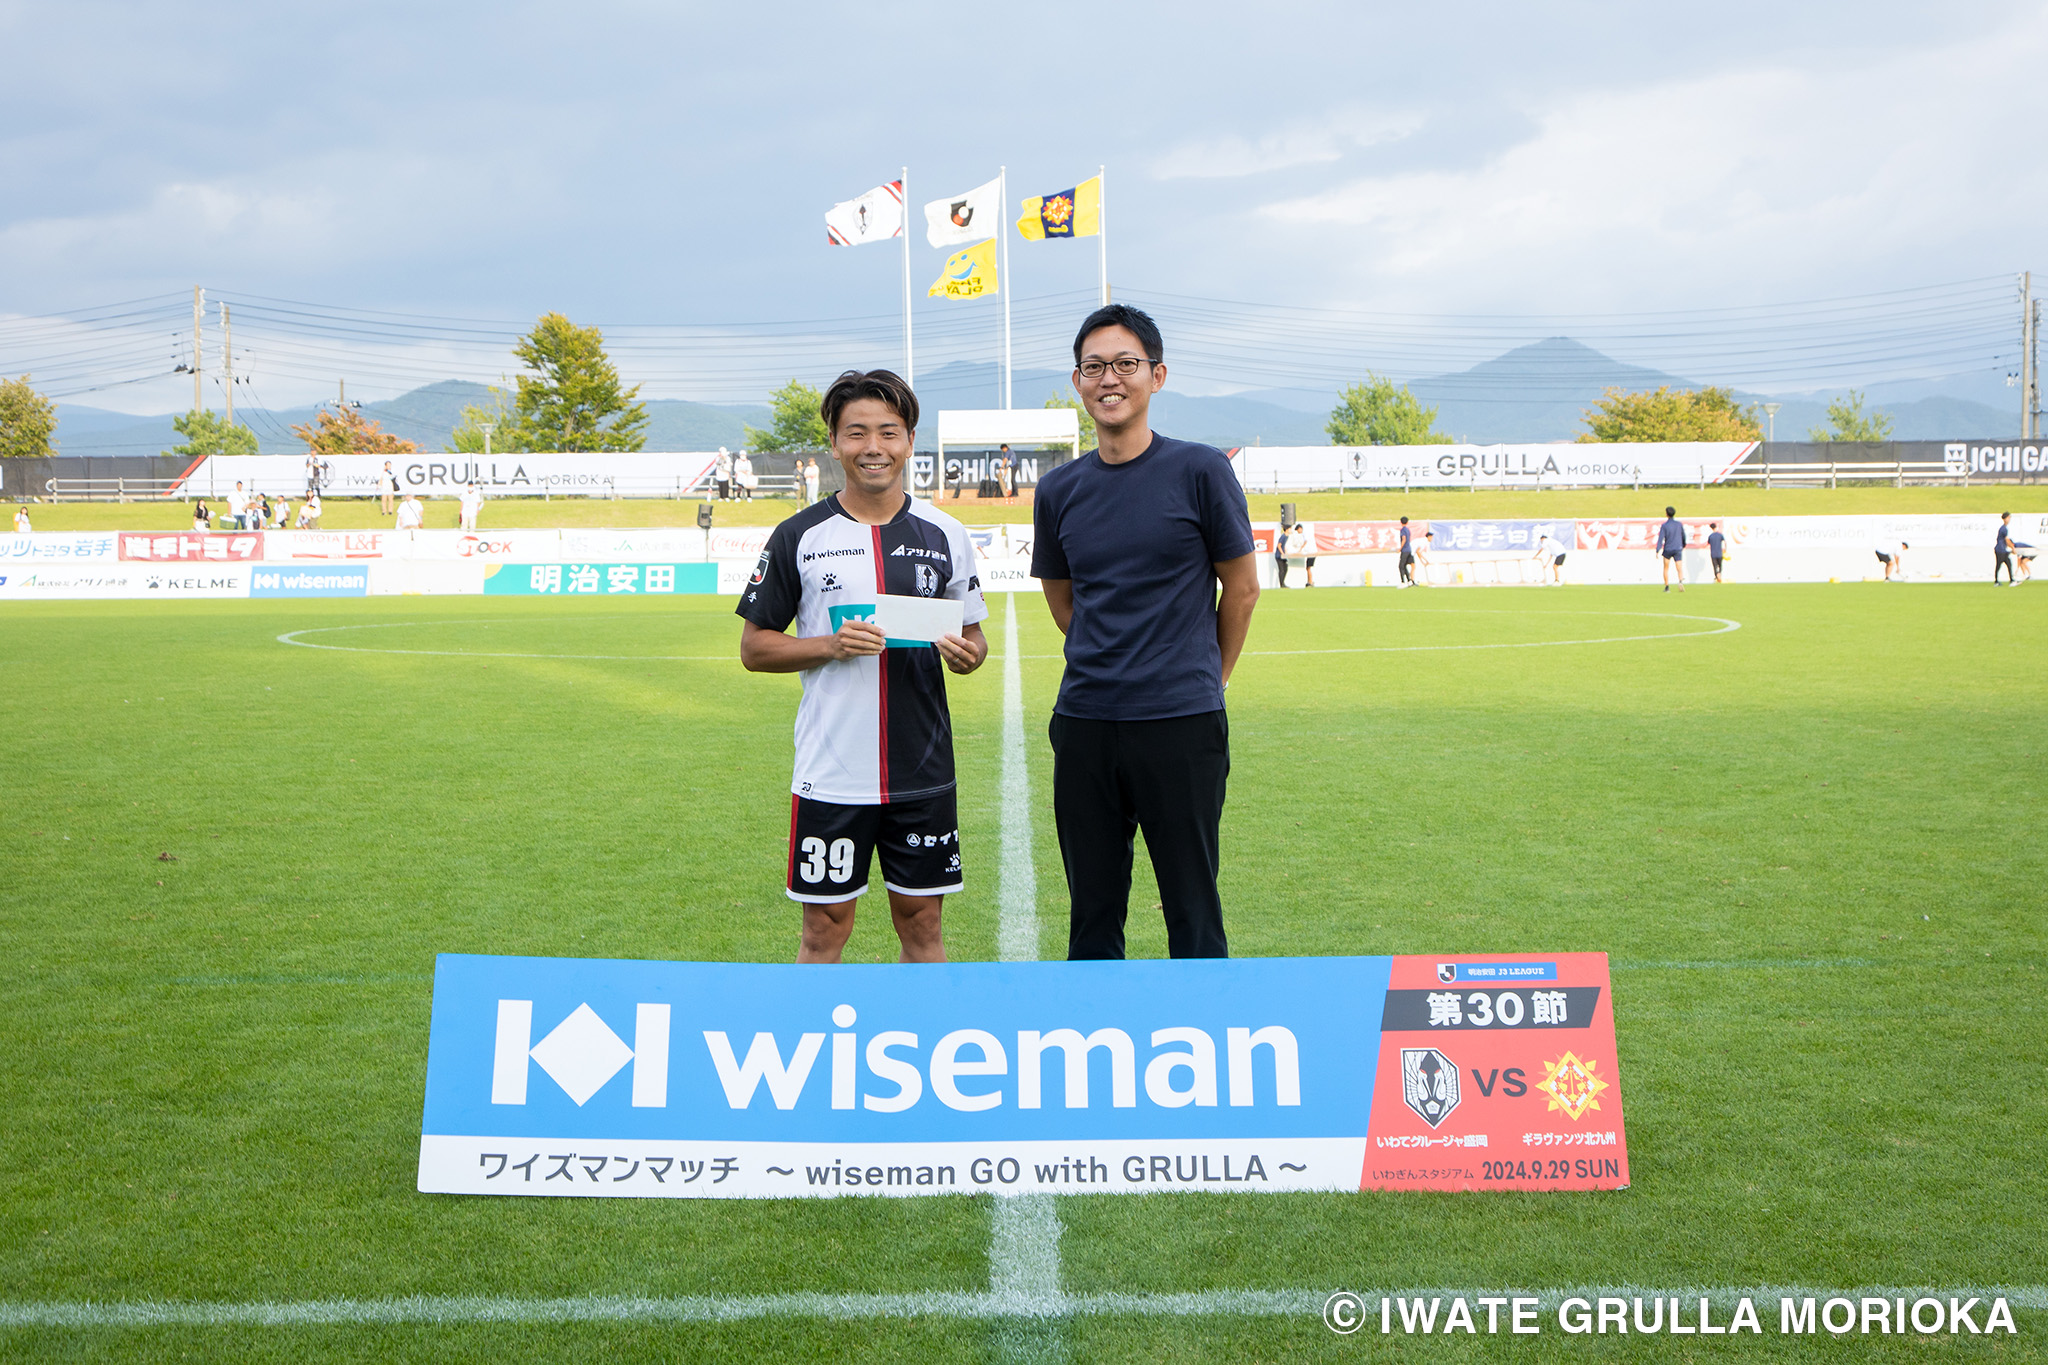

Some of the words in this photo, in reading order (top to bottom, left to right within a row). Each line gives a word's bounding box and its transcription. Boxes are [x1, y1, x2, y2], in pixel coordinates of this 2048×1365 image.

[406, 463, 532, 485] GRULLA
[537, 475, 612, 486] MORIOKA
[940, 458, 1038, 483] CHIGN
[1378, 466, 1430, 477] IWATE
[1437, 454, 1560, 476] GRULLA
[1567, 464, 1642, 476] MORIOKA
[124, 536, 257, 558] 岩手トヨタ
[293, 534, 340, 543] TOYOTA
[345, 534, 383, 550] L&F
[817, 548, 865, 559] wiseman
[168, 578, 238, 588] KELME
[281, 573, 365, 589] wiseman
[530, 565, 675, 593] 明治安田
[990, 570, 1025, 580] DAZN
[820, 584, 843, 593] KELME
[800, 836, 855, 884] 39
[1498, 968, 1508, 976] J3
[1509, 967, 1545, 976] LEAGUE
[1426, 991, 1567, 1026] 第30節
[703, 1004, 1301, 1113] wiseman
[1471, 1068, 1528, 1098] VS
[1376, 1134, 1488, 1148] いわてグルージャ盛岡
[1522, 1131, 1616, 1146] ギラヴァンツ北九州
[479, 1153, 739, 1184] ワイズマンマッチ
[806, 1159, 956, 1186] wiseman
[970, 1157, 1021, 1185] GO
[1034, 1156, 1107, 1183] with
[1122, 1155, 1268, 1182] GRULLA
[1372, 1168, 1475, 1180] いわぎんスタジアム
[1482, 1160, 1570, 1180] 2024.9.29
[1575, 1158, 1619, 1178] SUN
